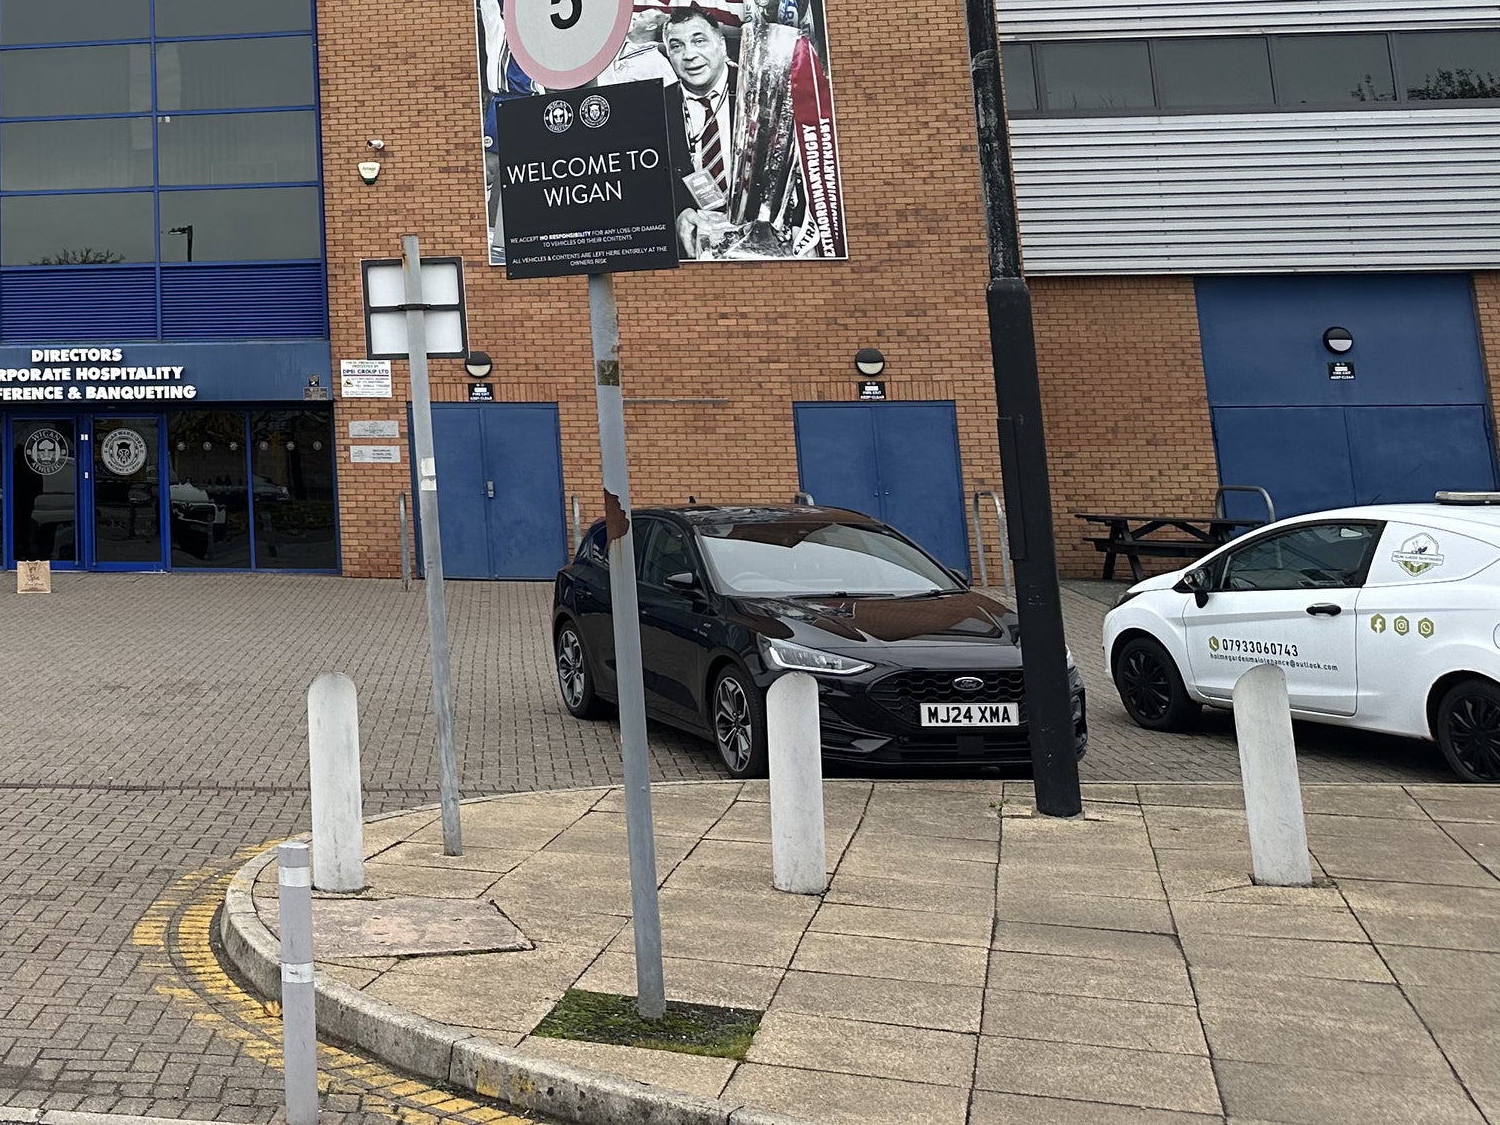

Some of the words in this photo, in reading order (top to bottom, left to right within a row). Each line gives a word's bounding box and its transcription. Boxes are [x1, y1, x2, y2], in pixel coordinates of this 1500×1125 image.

[507, 152, 622, 185] WELCOME
[626, 148, 659, 171] TO
[544, 180, 623, 207] WIGAN
[549, 231, 591, 240] RESPONSIBILITY
[641, 224, 666, 232] DAMAGE
[551, 239, 576, 247] VEHICLES
[602, 235, 632, 243] CONTENTS
[522, 255, 547, 263] VEHICLES
[552, 253, 581, 261] CONTENTS
[606, 249, 621, 257] HERE
[622, 247, 648, 255] ENTIRELY
[31, 348, 122, 363] DIRECTORS
[76, 366, 184, 381] HOSPITALITY
[67, 386, 81, 400] &
[85, 385, 197, 401] BANQUETING
[31, 431, 60, 442] WIGAN
[1222, 638, 1298, 657] 07933060743
[927, 706, 973, 723] MJ24
[978, 706, 1011, 723] XMA
